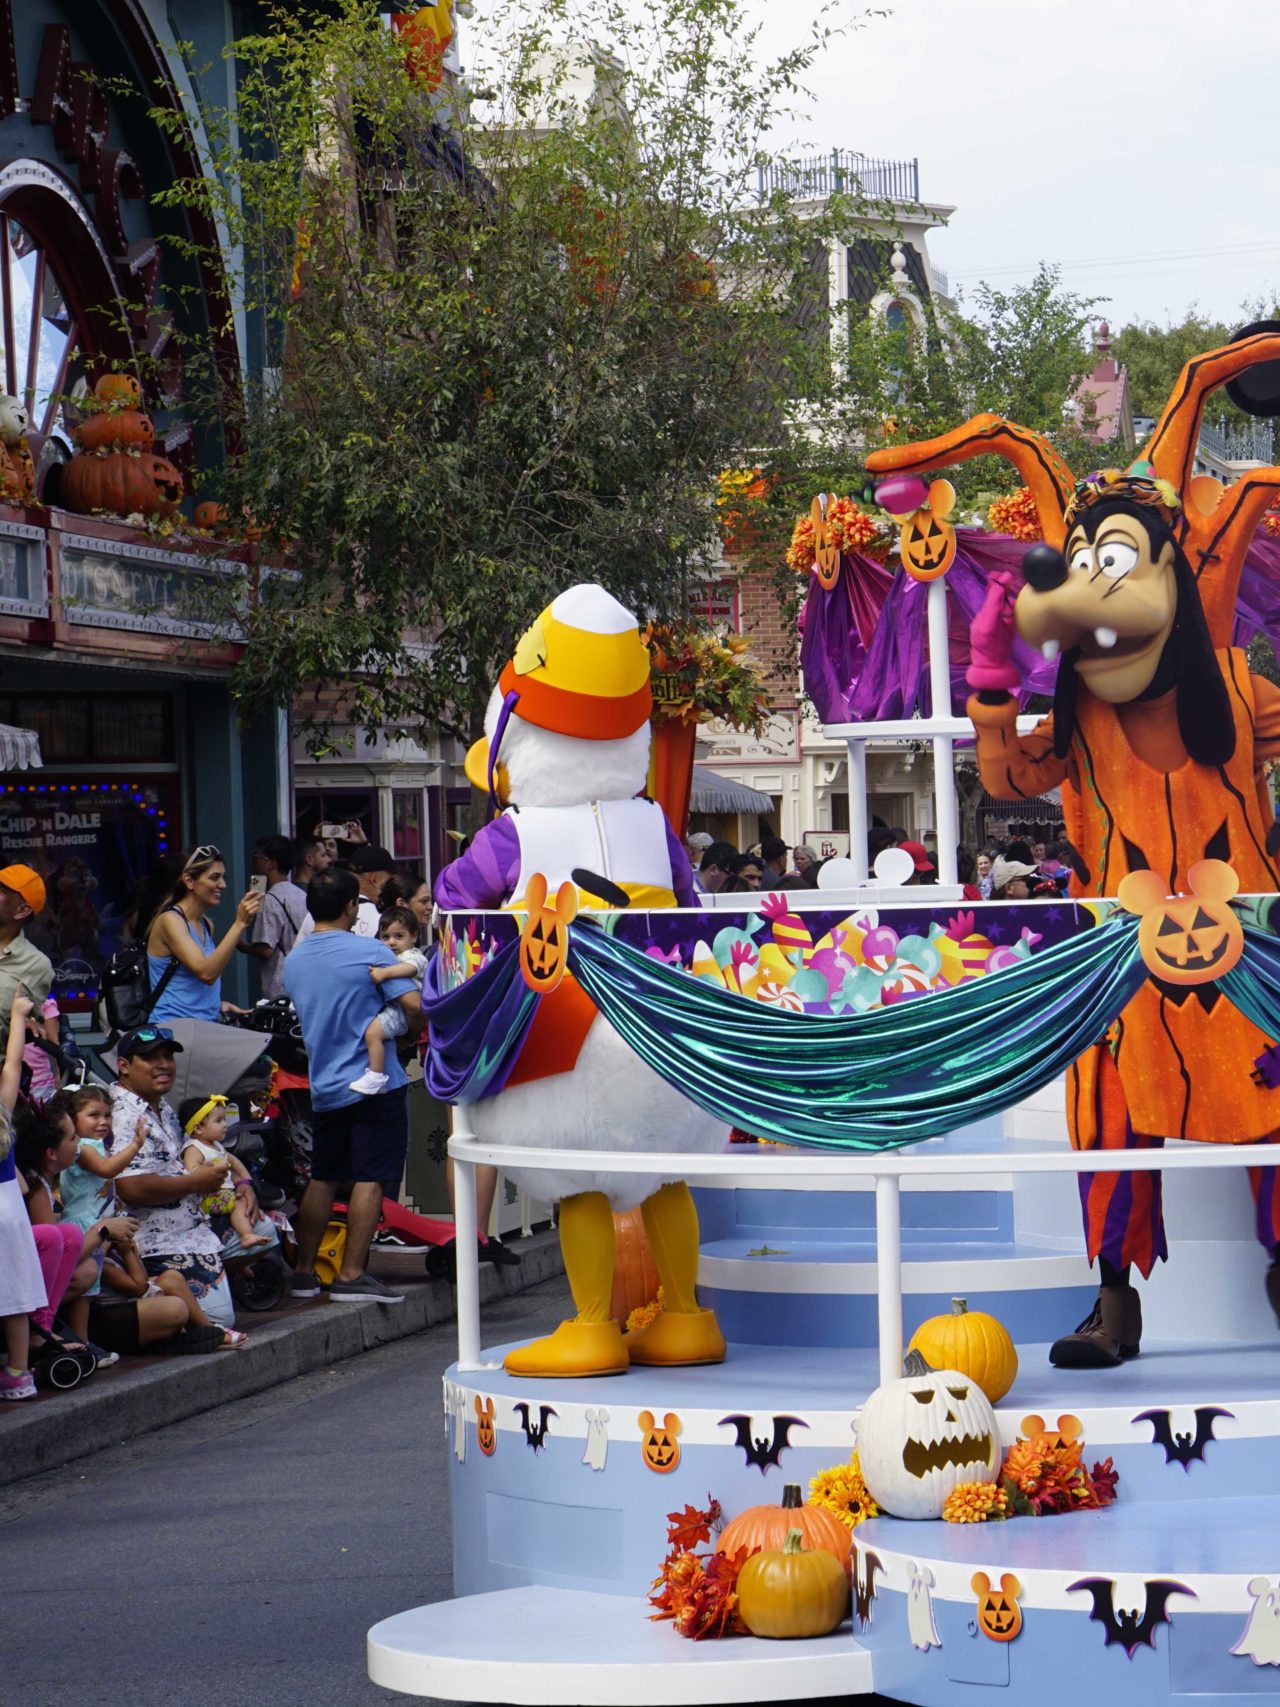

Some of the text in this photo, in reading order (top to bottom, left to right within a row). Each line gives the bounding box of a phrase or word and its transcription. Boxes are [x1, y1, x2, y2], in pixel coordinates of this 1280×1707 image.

[0, 814, 37, 834] CHIP
[55, 811, 102, 831] DALE
[2, 833, 97, 850] RESCUE RANGERS
